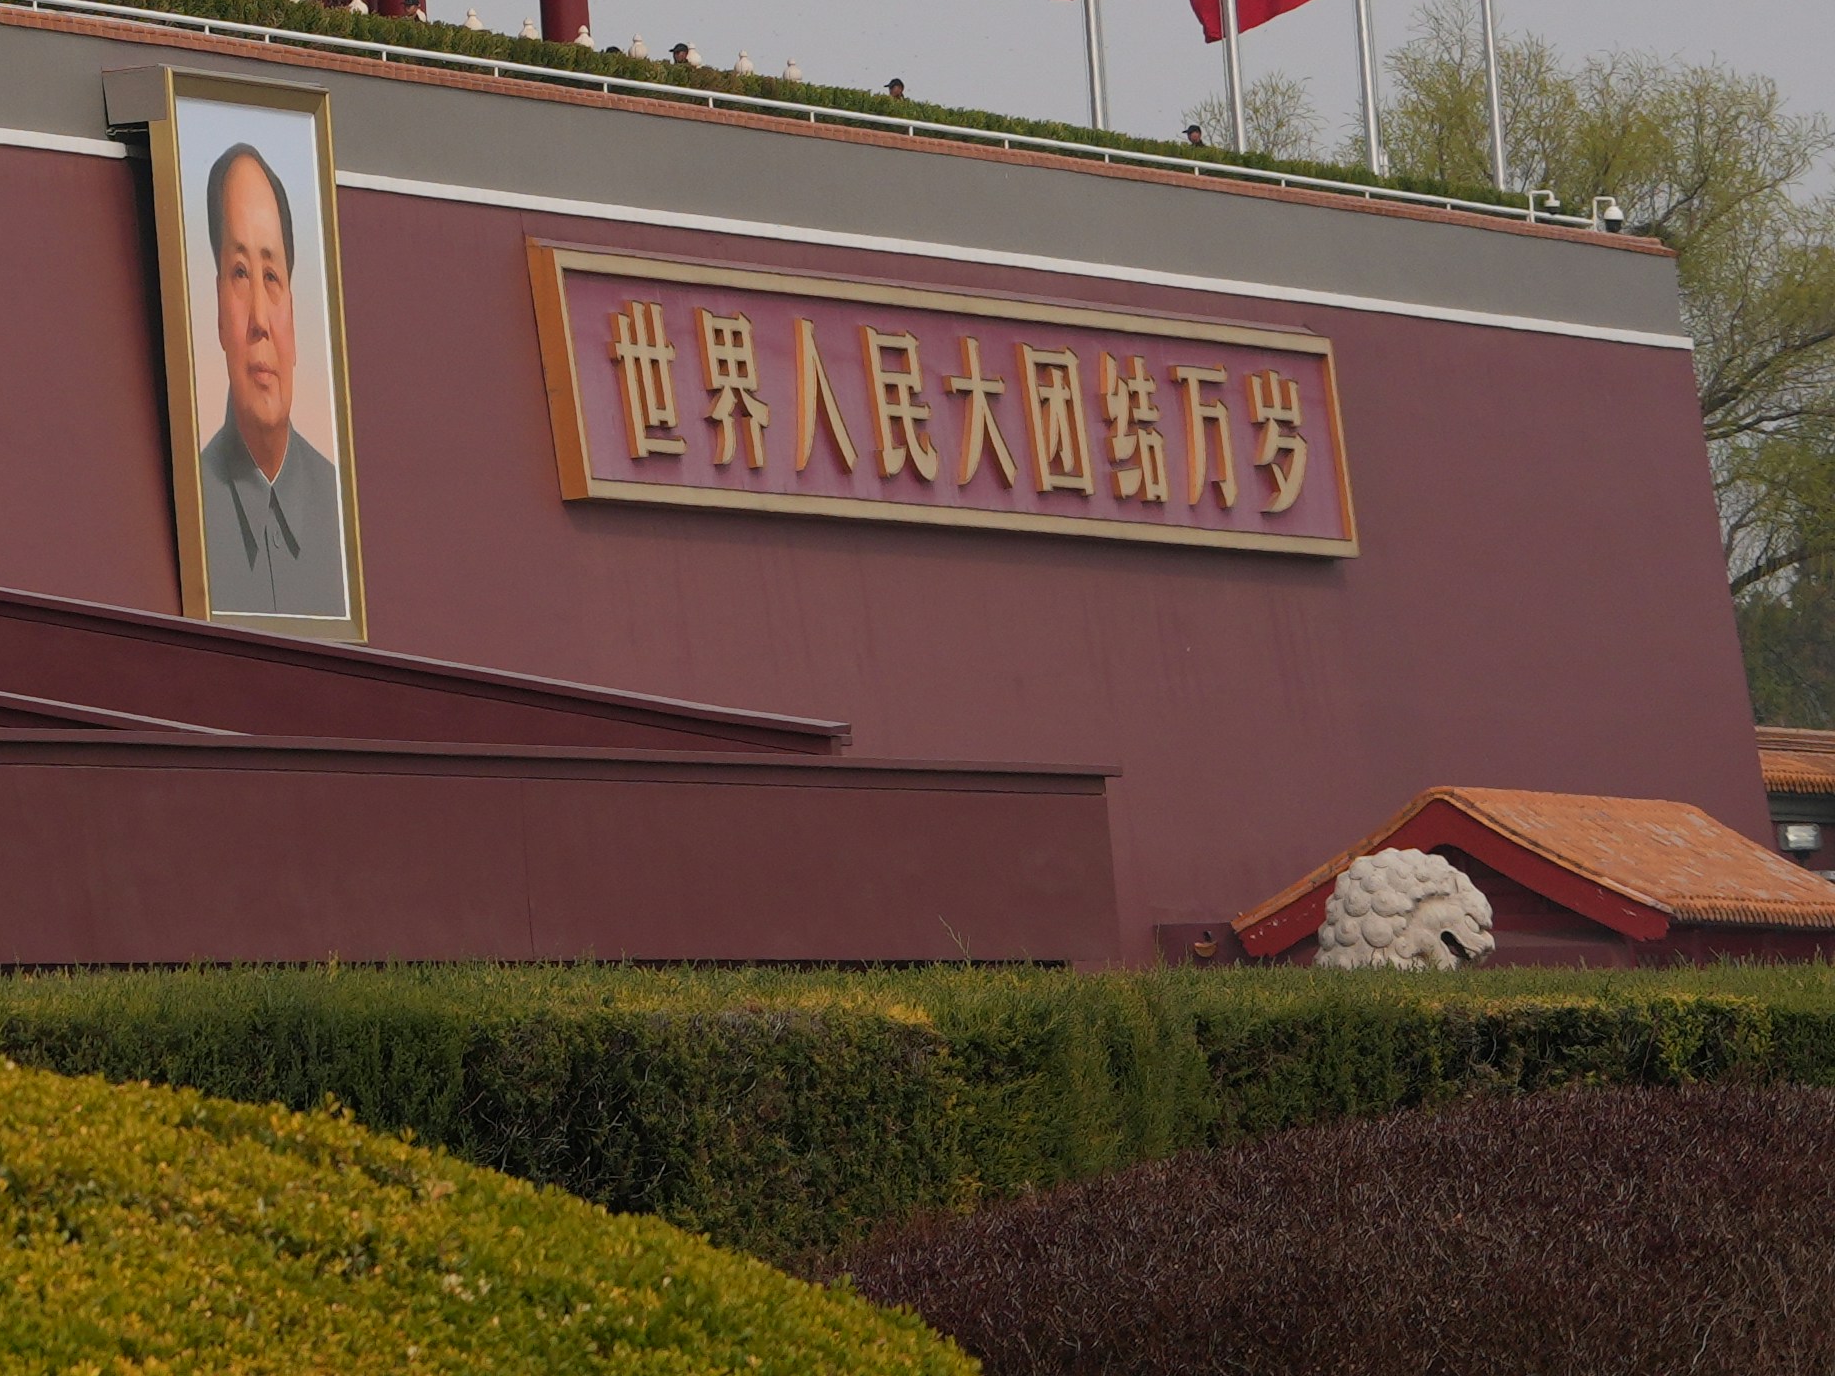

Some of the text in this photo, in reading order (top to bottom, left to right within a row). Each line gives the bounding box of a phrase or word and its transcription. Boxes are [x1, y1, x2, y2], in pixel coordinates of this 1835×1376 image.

[613, 301, 1308, 514] 世界人民大团结万岁
